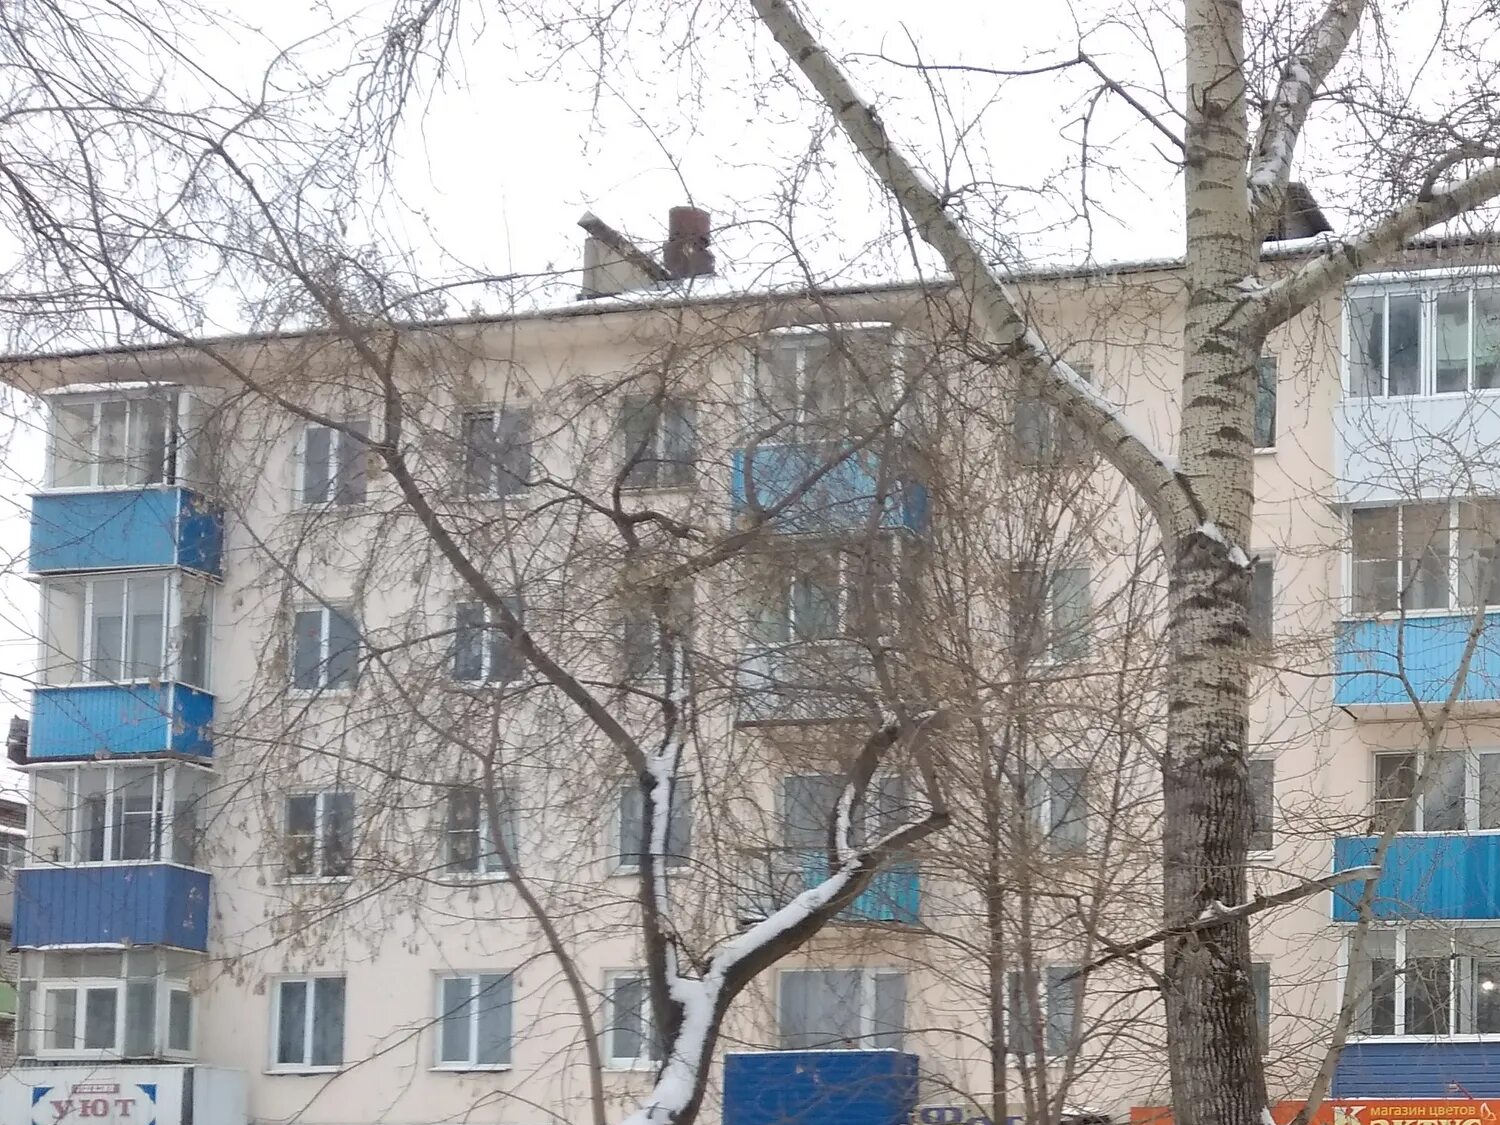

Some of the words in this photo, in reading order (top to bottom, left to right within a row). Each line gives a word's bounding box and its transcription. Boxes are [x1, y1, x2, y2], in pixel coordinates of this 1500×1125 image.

[51, 1099, 136, 1120] УЮТ
[1371, 1106, 1425, 1116] магазин
[1429, 1106, 1476, 1117] цветов
